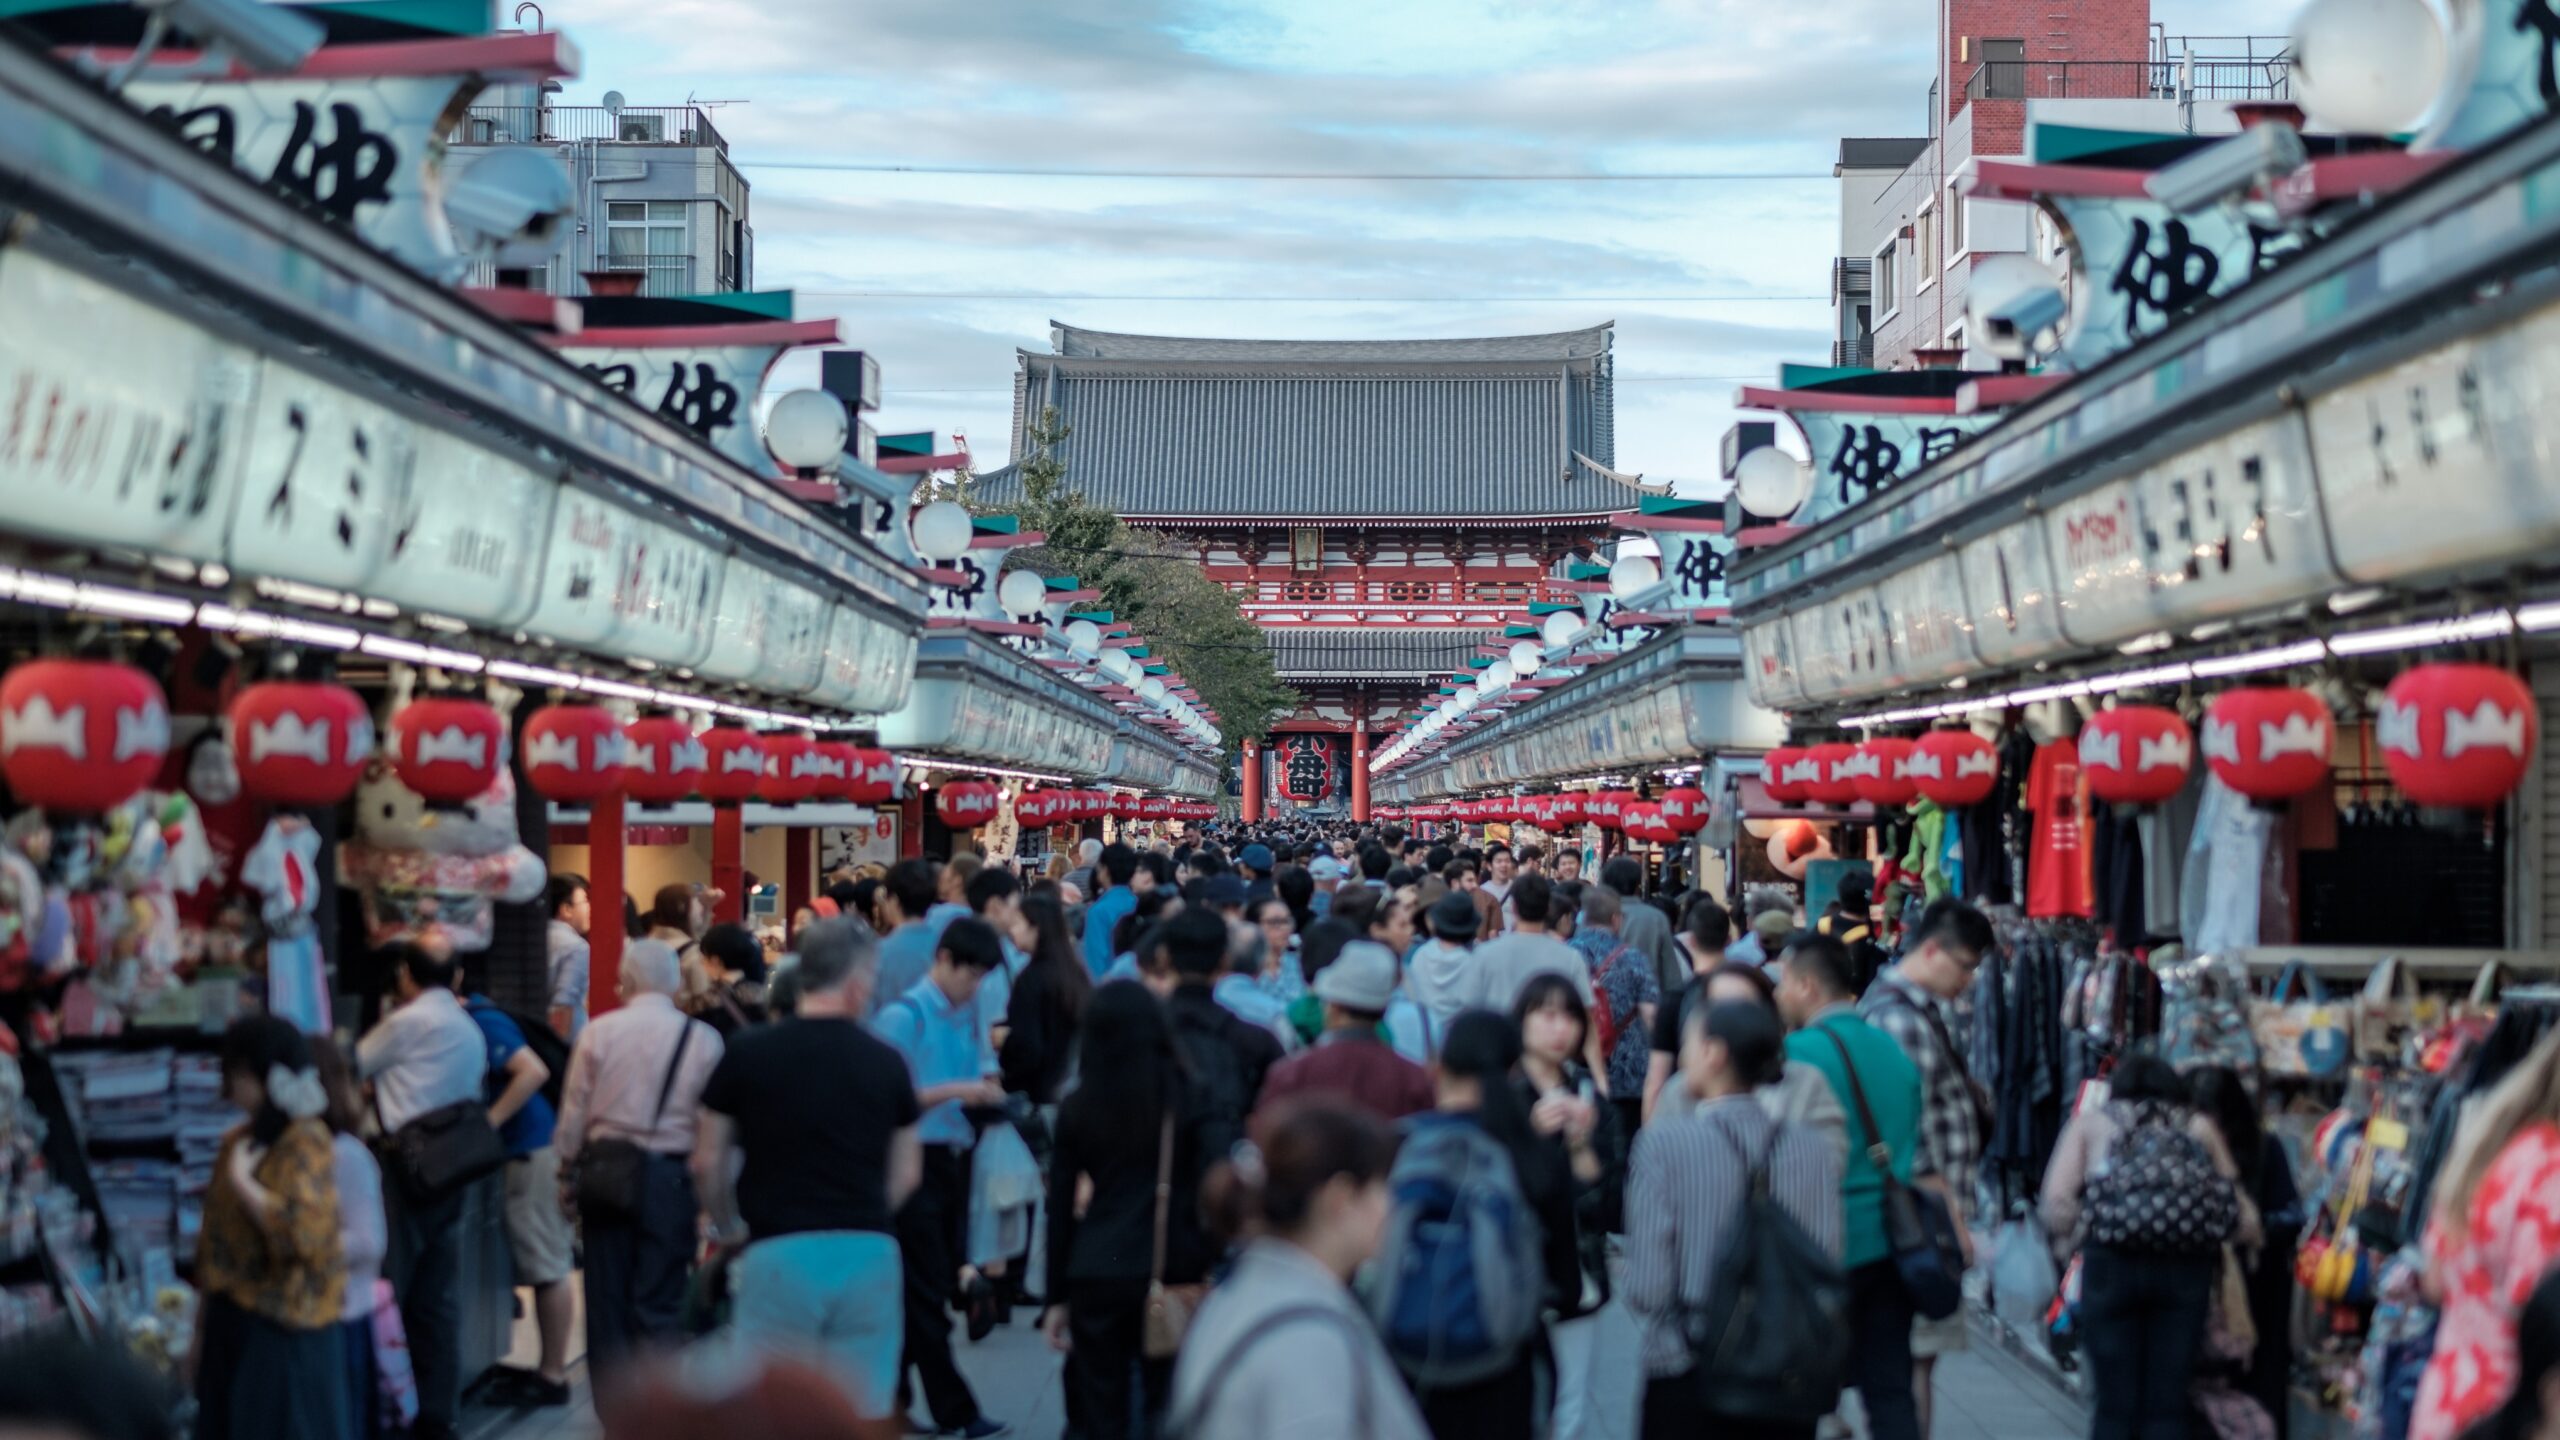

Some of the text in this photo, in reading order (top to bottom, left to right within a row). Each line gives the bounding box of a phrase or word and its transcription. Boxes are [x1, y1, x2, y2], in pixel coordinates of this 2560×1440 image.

[1674, 539, 1725, 600] 仲
[1286, 734, 1328, 798] 小舟町
